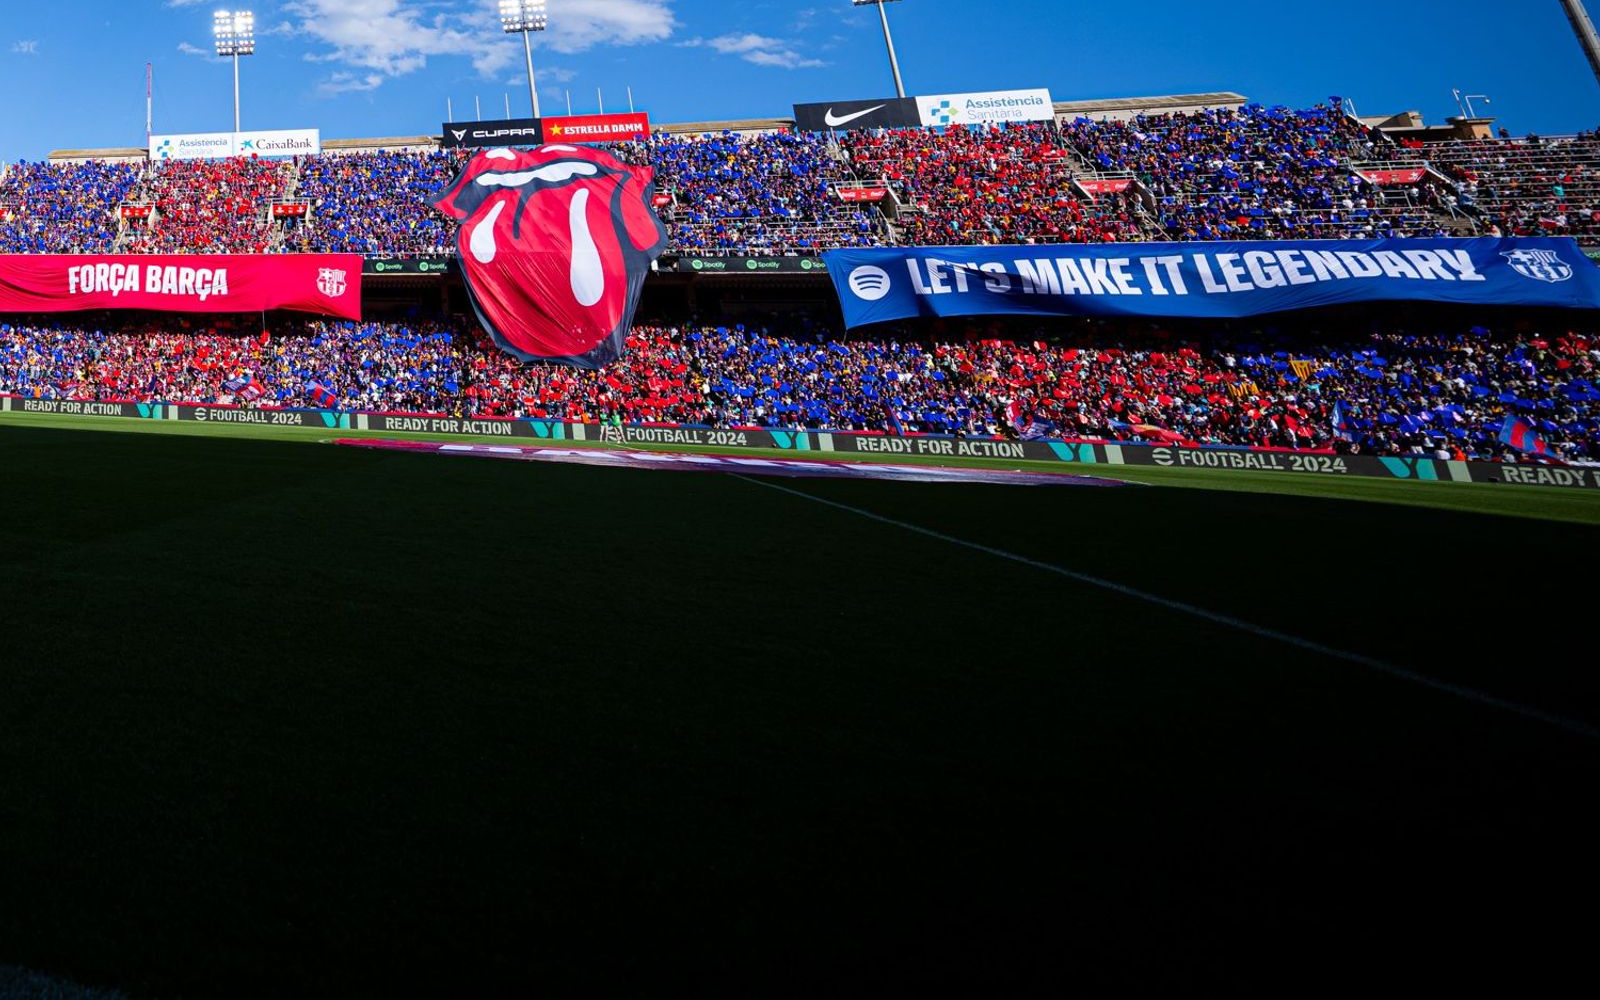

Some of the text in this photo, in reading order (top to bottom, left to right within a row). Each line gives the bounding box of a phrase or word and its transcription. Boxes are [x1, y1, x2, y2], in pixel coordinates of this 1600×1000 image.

[472, 127, 535, 138] CUPRA
[564, 123, 643, 135] ESTRELLA DAMM
[256, 138, 312, 150] CaixaBank
[703, 261, 726, 270] Spotify
[758, 261, 780, 270] Spotify
[906, 248, 1486, 296] LET'S MAKE IT LEGENDARY
[68, 263, 228, 302] FORÇA BARÇA
[24, 400, 122, 416] READY FOR ACTION
[210, 409, 302, 425] FOOTBALL 2024
[385, 417, 512, 435] READY FOR ACTION
[626, 428, 747, 446] FOOTBALL 2024
[856, 436, 1025, 458] READY FOR ACTION
[1177, 450, 1348, 474] FOOTBALL 2024
[1501, 465, 1586, 487] READY
